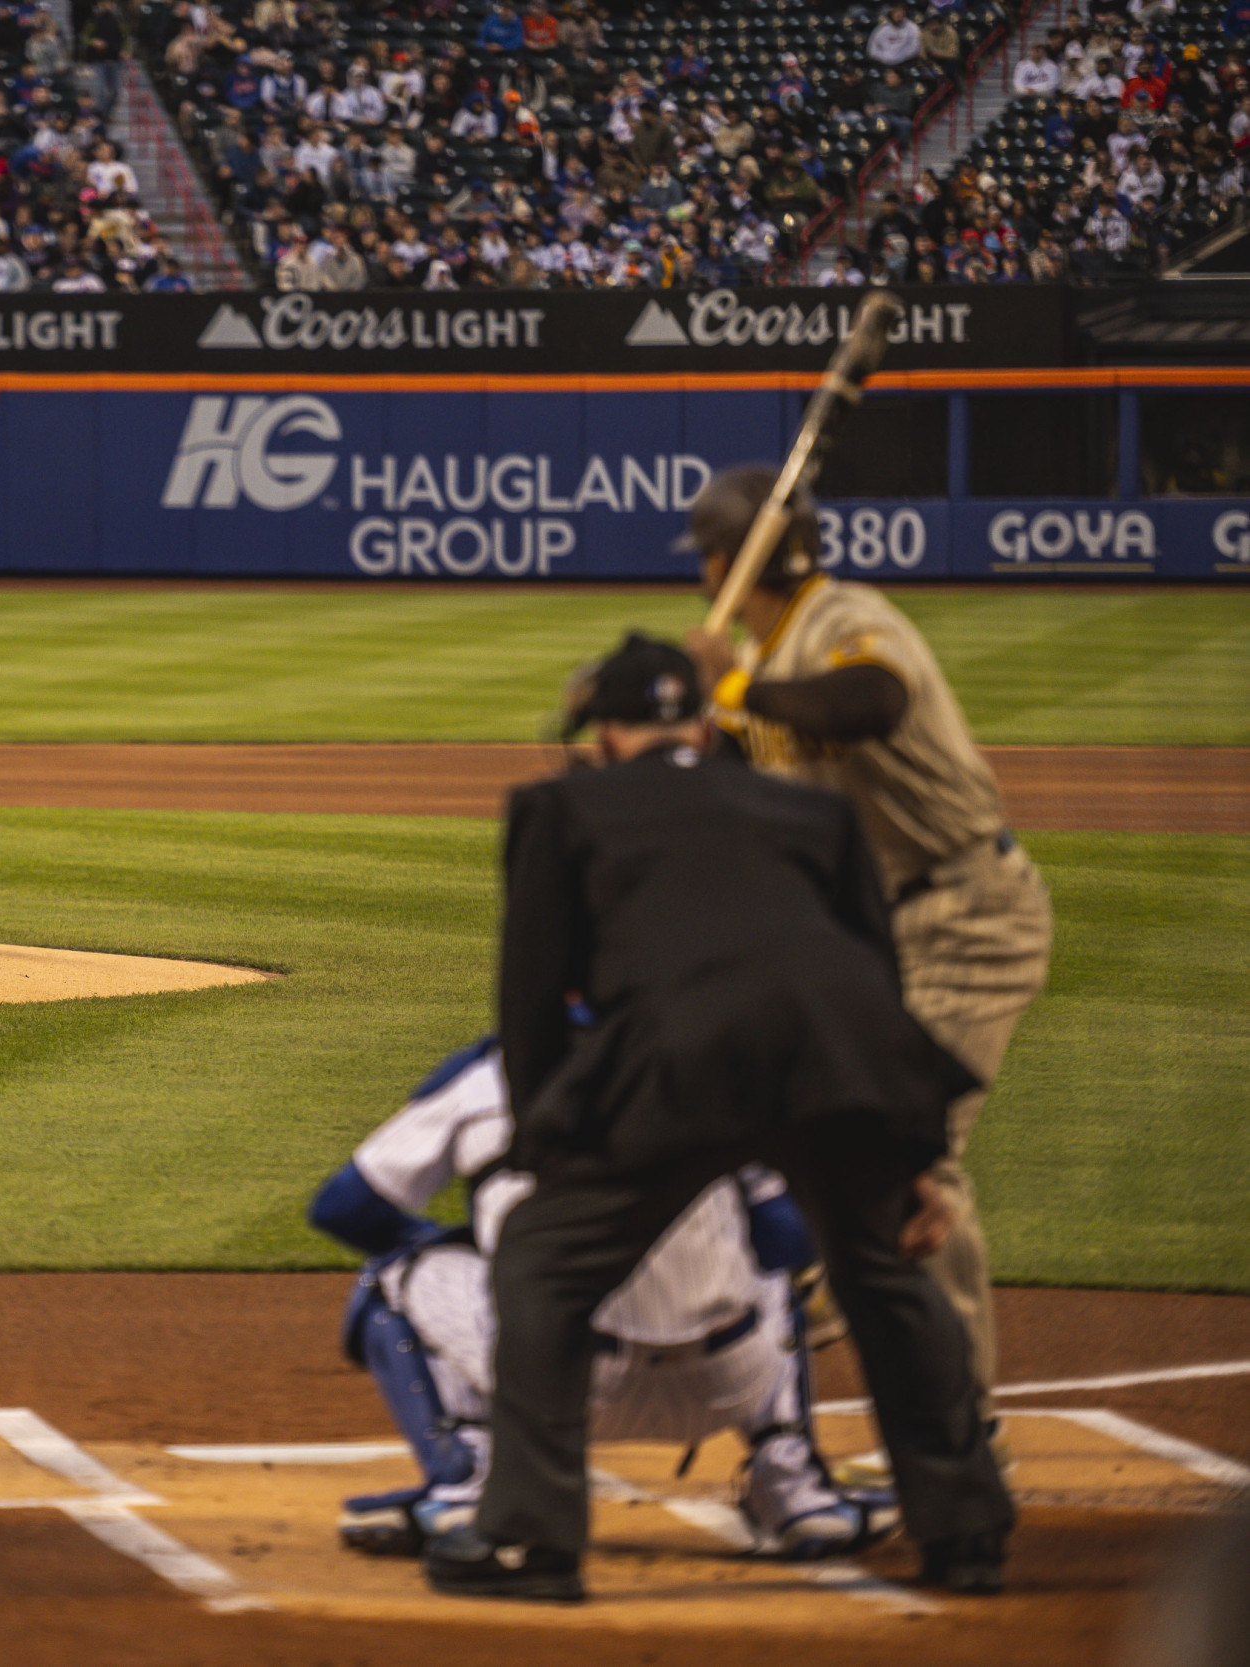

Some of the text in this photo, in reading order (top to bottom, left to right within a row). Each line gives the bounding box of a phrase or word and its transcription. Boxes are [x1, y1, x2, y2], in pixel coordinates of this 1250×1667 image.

[261, 294, 545, 350] Coors LIGHT
[687, 290, 971, 346] Coors LGHT
[352, 454, 711, 512] HAUGLAND
[350, 516, 576, 575] GROUP
[817, 508, 926, 569] 380
[988, 509, 1157, 562] GOYA
